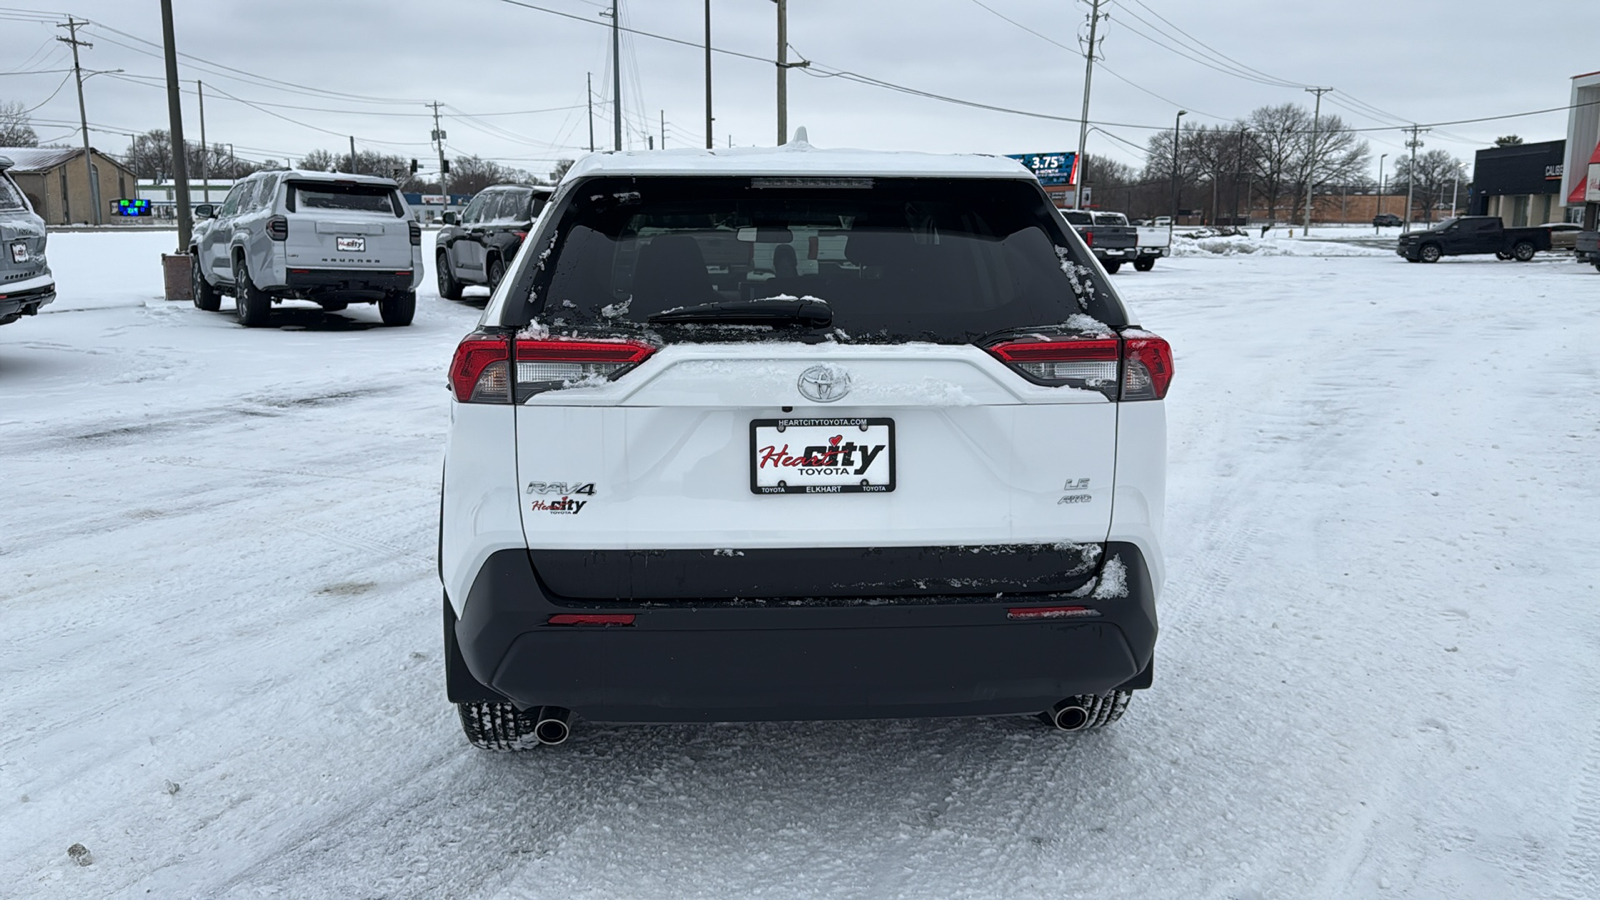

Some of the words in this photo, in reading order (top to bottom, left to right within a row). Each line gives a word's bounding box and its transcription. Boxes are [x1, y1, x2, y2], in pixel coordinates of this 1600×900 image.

[759, 444, 849, 469] Heart
[802, 435, 886, 475] city
[526, 481, 597, 496] RAV4
[1064, 478, 1090, 490] LE
[1057, 494, 1092, 505] AWD
